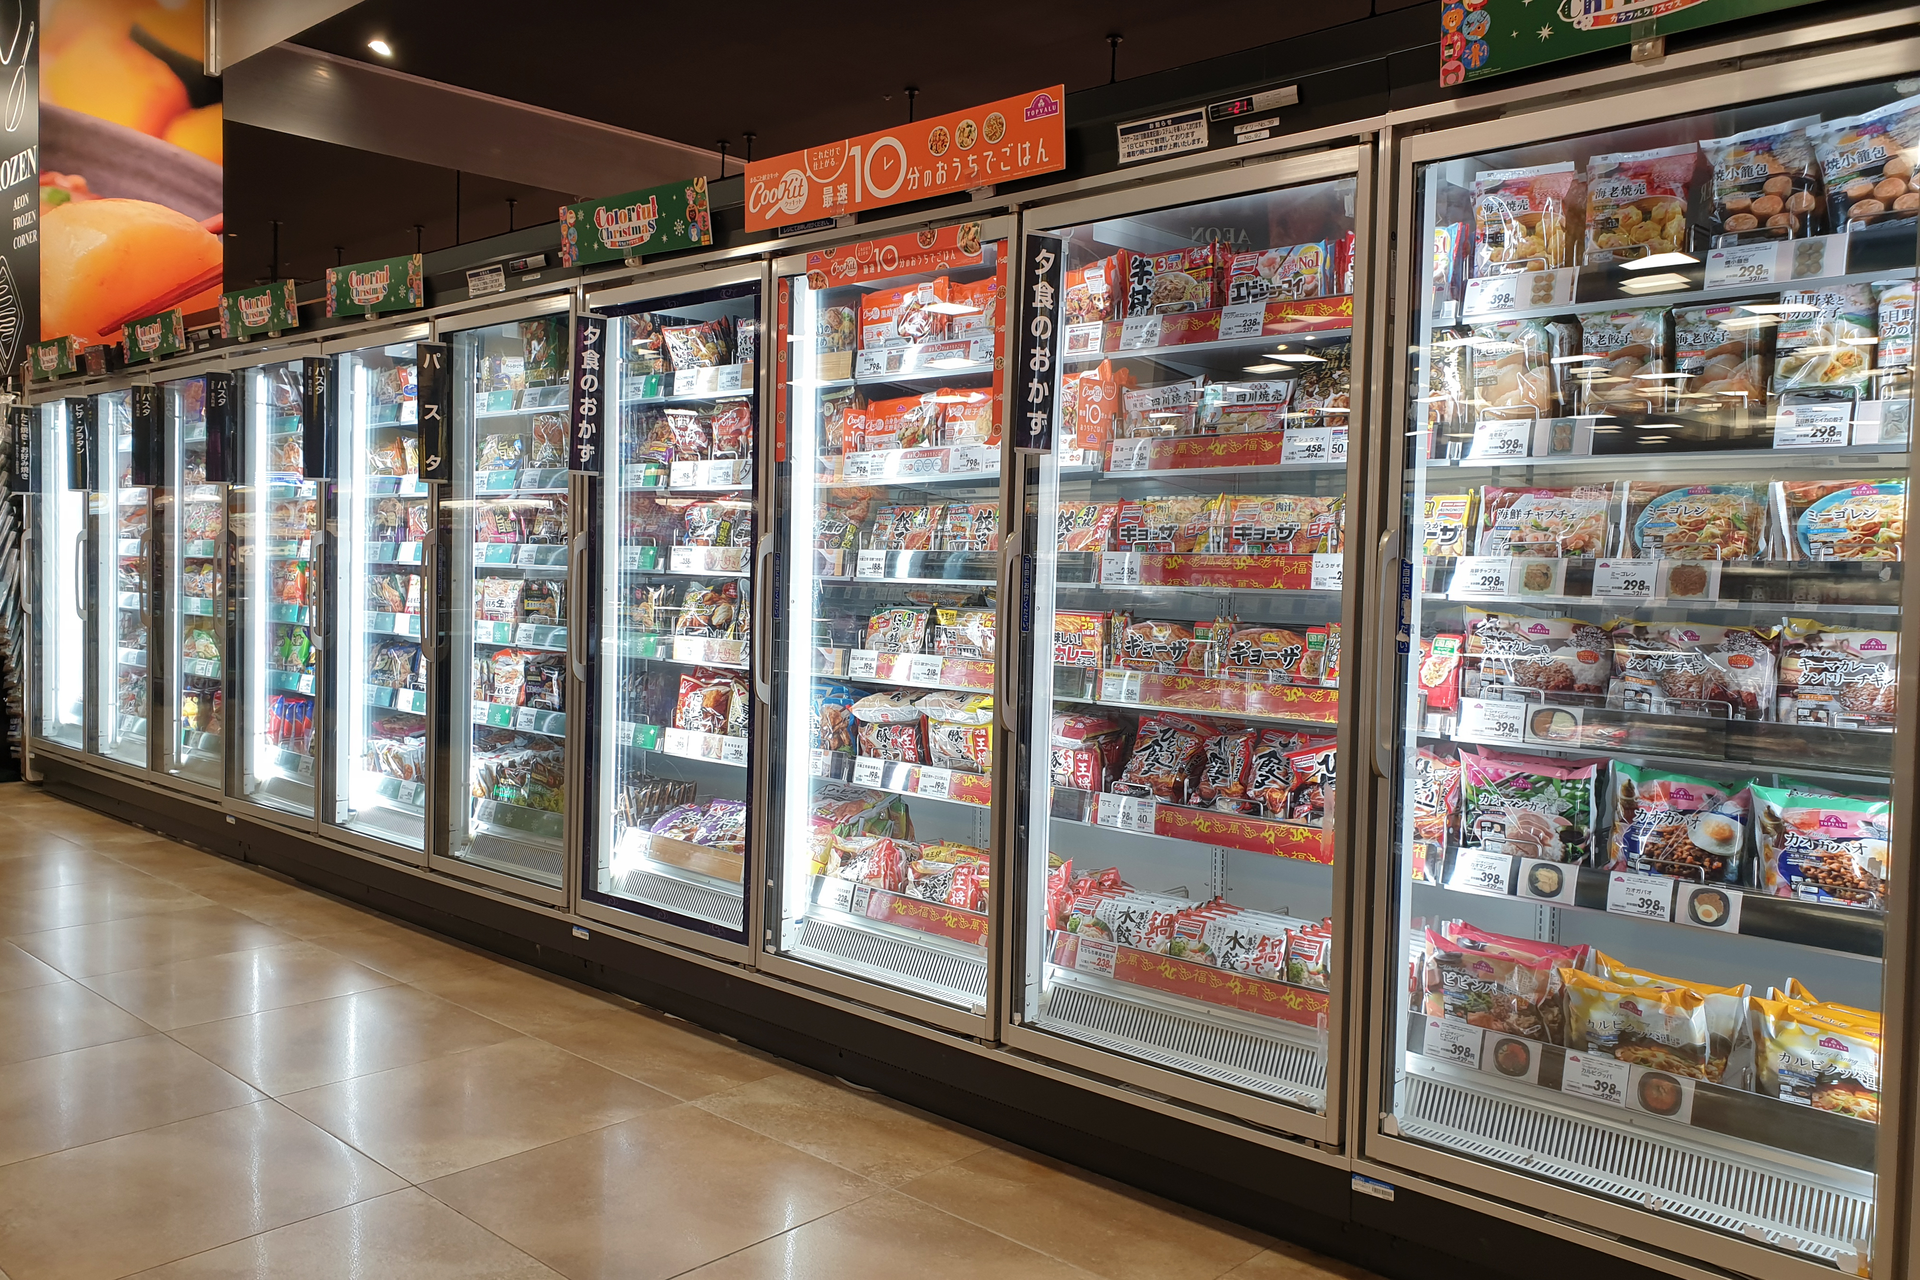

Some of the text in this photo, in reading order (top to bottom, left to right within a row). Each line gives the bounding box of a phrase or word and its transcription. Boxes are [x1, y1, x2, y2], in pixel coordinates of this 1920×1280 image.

[1027, 105, 1057, 117] TOPVALU
[1228, 101, 1248, 114] -21
[1149, 119, 1172, 129] お知らせ
[812, 147, 841, 161] これだけで
[1825, 146, 1887, 173] 焼小籠包
[0, 145, 37, 191] OZEN
[1595, 183, 1648, 200] 海老焼売
[13, 193, 29, 211] AEON
[594, 195, 658, 228] Colorful
[13, 210, 36, 230] FROZEN
[599, 219, 656, 242] Christmas
[13, 230, 37, 249] CORNER
[349, 265, 389, 287] Colorful
[1738, 263, 1770, 279] 298円
[351, 284, 388, 298] Christmas
[238, 290, 272, 309] Colorful
[1782, 293, 1845, 308] 五目野菜と
[1027, 249, 1056, 437] 夕食のおかず
[1583, 332, 1633, 347] 海老餃子
[1676, 330, 1730, 346] 海老餃子
[315, 366, 325, 394] パスタ
[217, 381, 227, 406] パスタ
[577, 326, 601, 463] 夕食のおかず
[1151, 393, 1193, 408] 四川焼売
[1236, 389, 1284, 403] 四川焼売
[142, 392, 151, 417] パスタ
[423, 352, 442, 472] パスタ
[1810, 425, 1842, 439] 298円
[1499, 438, 1524, 450] 398円
[1156, 504, 1172, 514] 肉汁
[1275, 501, 1292, 512] 肉汁
[1497, 508, 1577, 521] 海鮮チャプチェ
[1647, 504, 1708, 519] ミーゴレン
[1806, 508, 1878, 522] ミーゴレン
[1119, 523, 1179, 544] ギョーザ
[1233, 522, 1301, 543] ギョーザ
[1480, 576, 1505, 587] 298円
[1623, 579, 1651, 591] 298円
[1124, 634, 1188, 661] ギョーザ
[1229, 640, 1302, 670] ギョーザ
[1860, 643, 1888, 652] TOPVALU
[1798, 659, 1887, 674] キーマカレー&
[1494, 721, 1519, 735] 398円
[1633, 808, 1702, 830] カオガパオ
[1819, 821, 1848, 830] TOPVALU
[1784, 831, 1869, 856] カオガパオ
[1480, 871, 1505, 886] 398円
[1626, 886, 1653, 896] カオガパオ
[1637, 896, 1665, 912] 398円
[1451, 1043, 1476, 1061] 398円
[1819, 1040, 1849, 1053] TOPVALU
[1776, 1050, 1870, 1082] カルビクッパ
[1592, 1079, 1622, 1098] 398円
